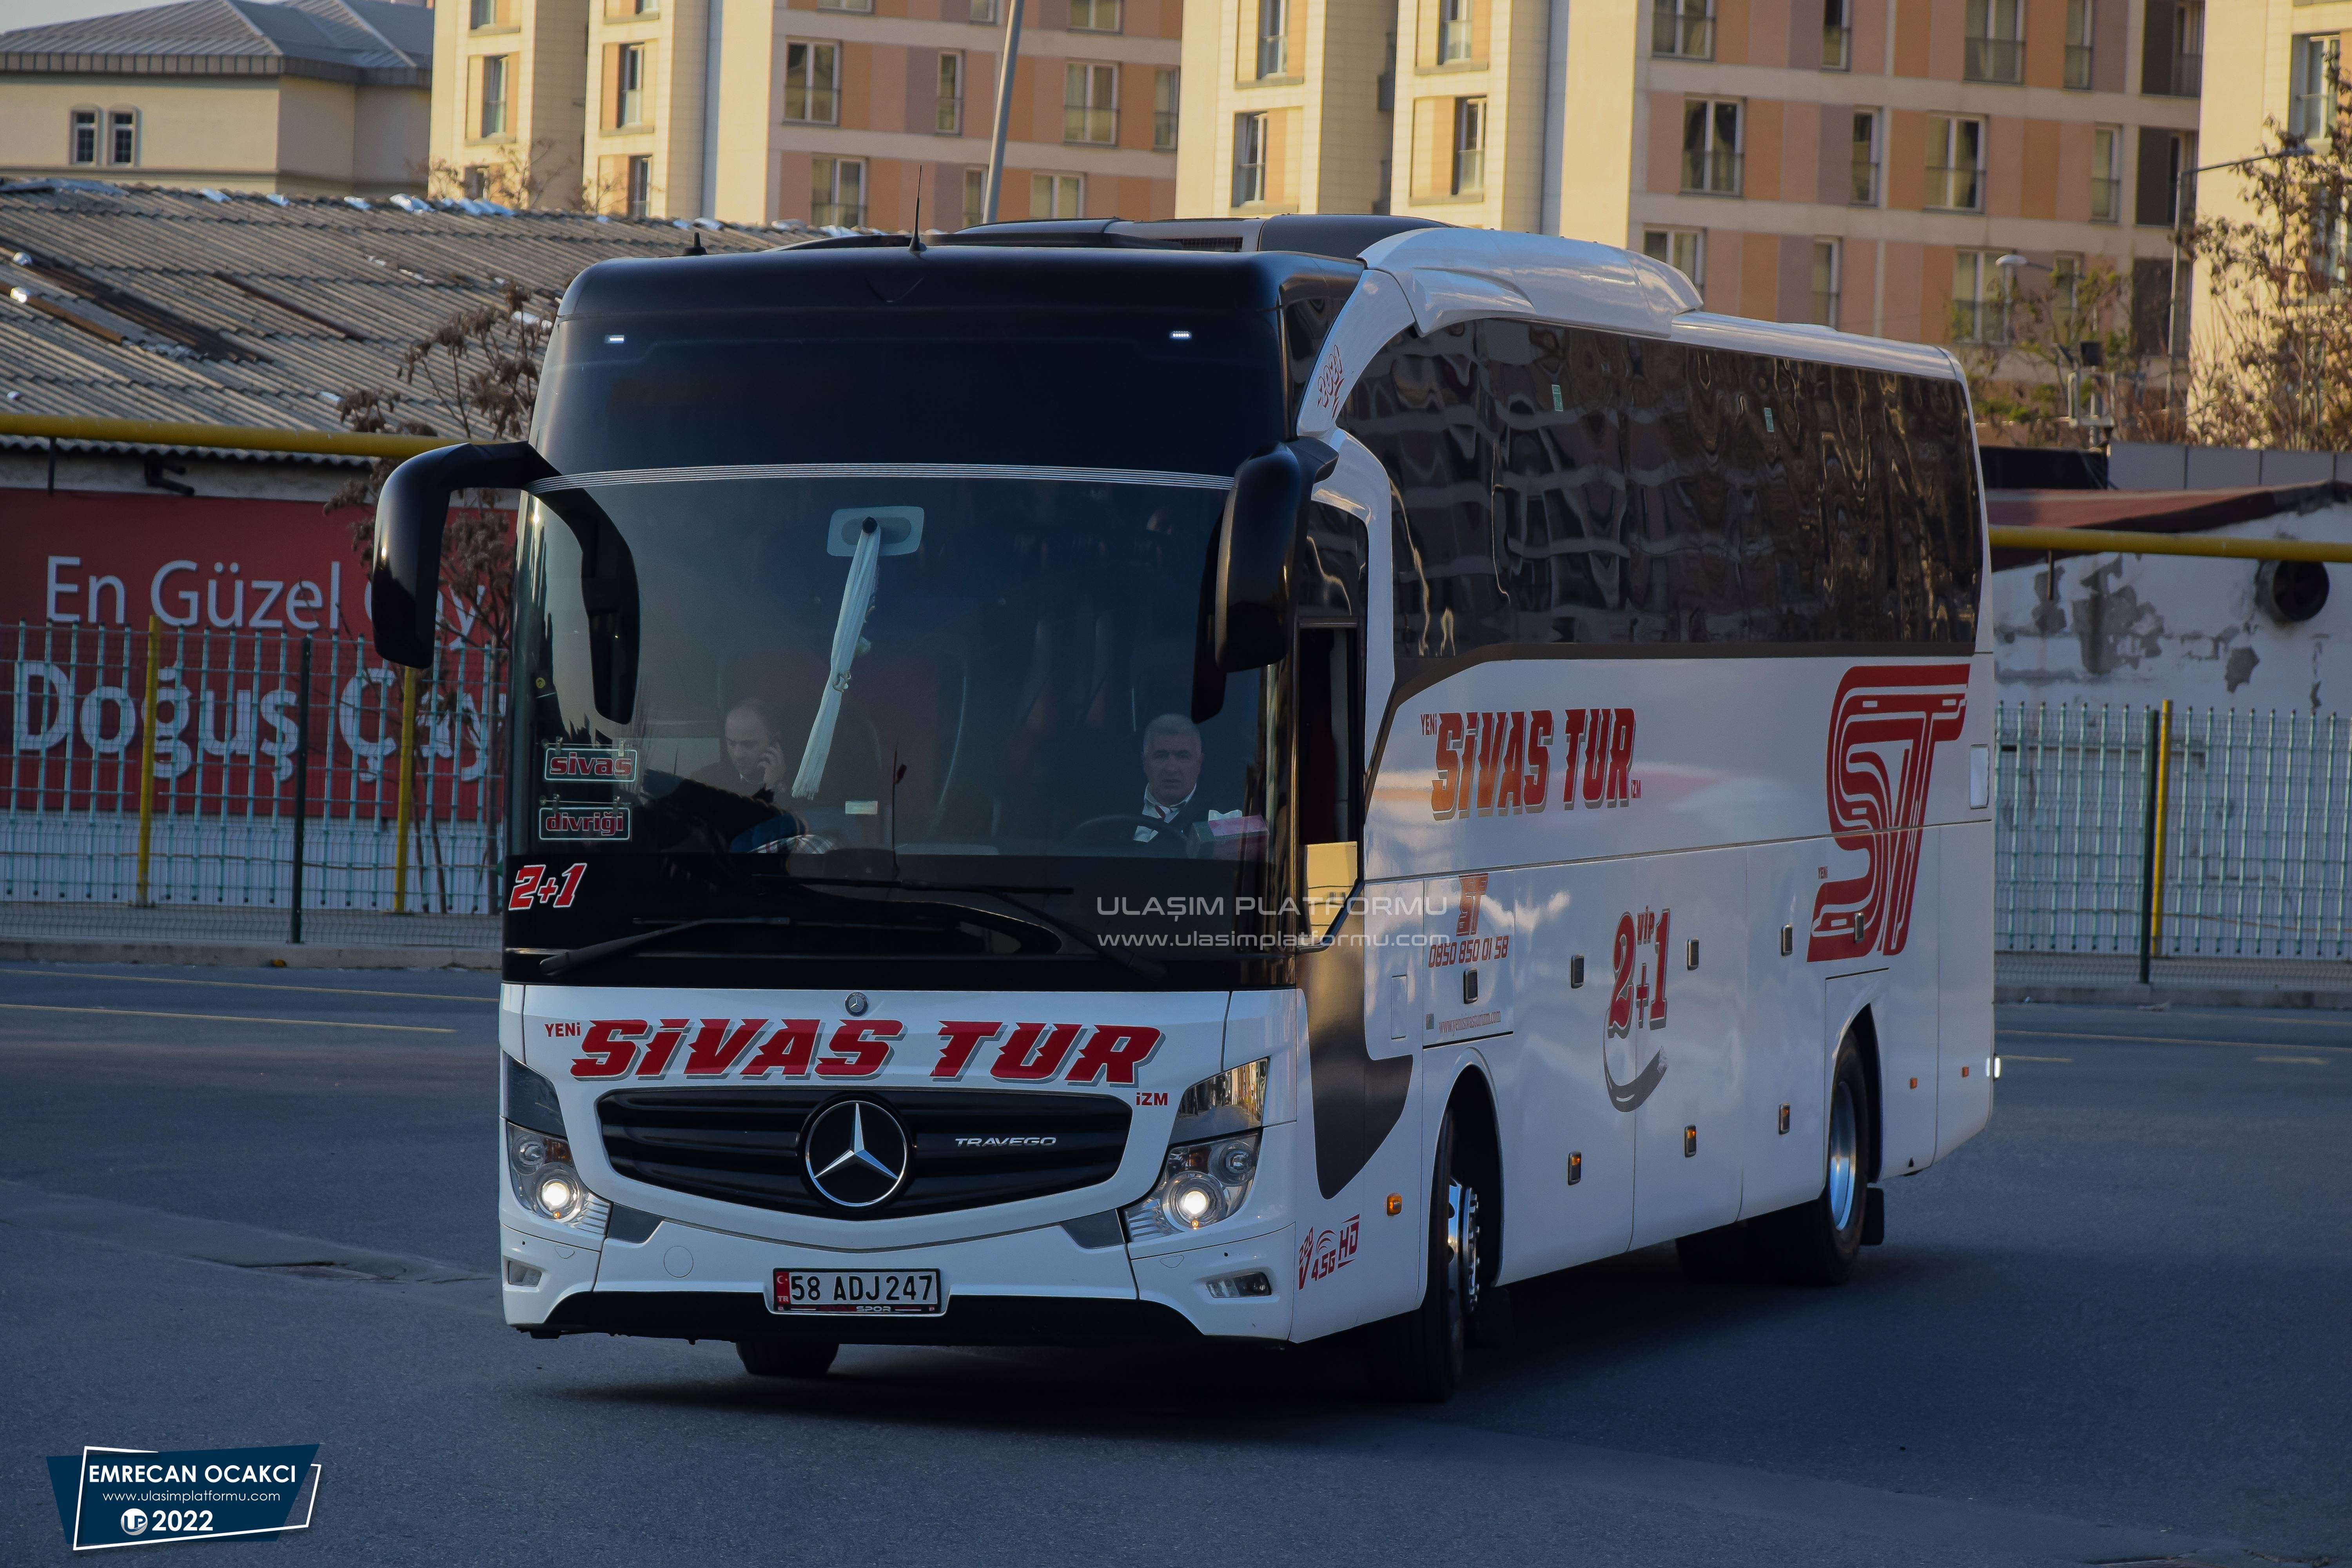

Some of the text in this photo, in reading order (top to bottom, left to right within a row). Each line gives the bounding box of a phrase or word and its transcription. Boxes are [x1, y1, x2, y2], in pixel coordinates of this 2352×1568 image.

[47, 555, 126, 623] En
[151, 561, 340, 628] Güzel
[13, 660, 299, 783] Doğuş
[550, 752, 632, 775] sivas
[1563, 708, 1637, 810] TUR
[546, 811, 623, 836] divriği
[508, 863, 587, 910] 2+1
[1428, 935, 1509, 968] 0850 850 01 58
[929, 1020, 1165, 1088] TUR
[955, 1137, 1056, 1147] TRAVEGO
[1338, 1220, 1360, 1261] HD
[791, 1275, 821, 1301] 58
[833, 1275, 879, 1301] ADJ
[886, 1275, 933, 1301] 247
